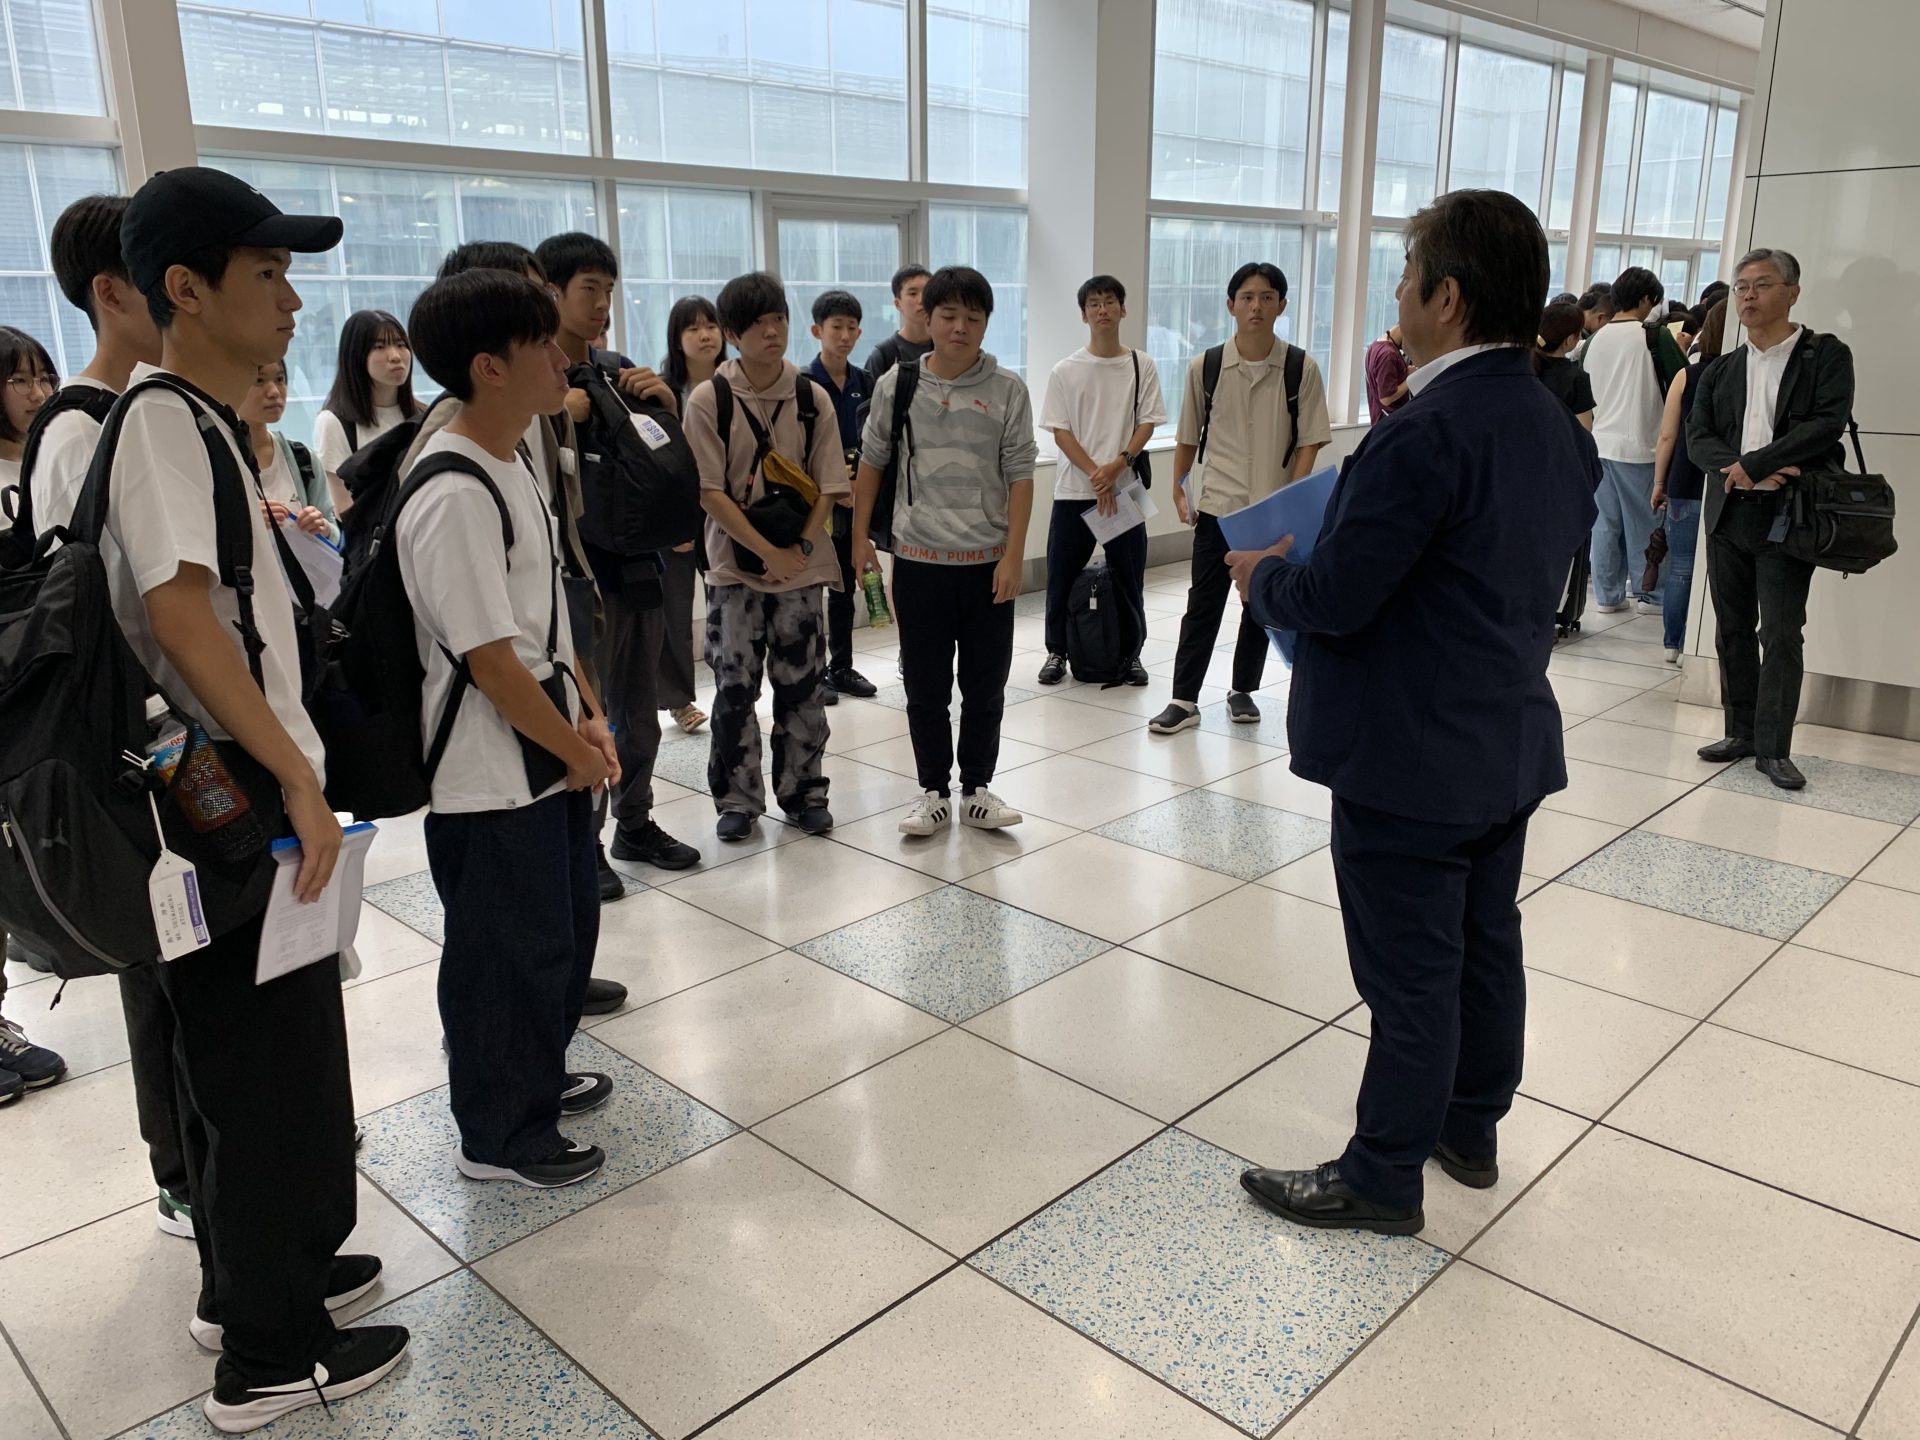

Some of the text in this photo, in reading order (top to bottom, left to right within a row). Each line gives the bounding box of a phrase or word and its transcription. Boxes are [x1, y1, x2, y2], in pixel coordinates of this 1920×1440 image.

[902, 544, 938, 561] PUMA
[947, 550, 985, 562] PUMA
[992, 544, 1007, 558] PU
